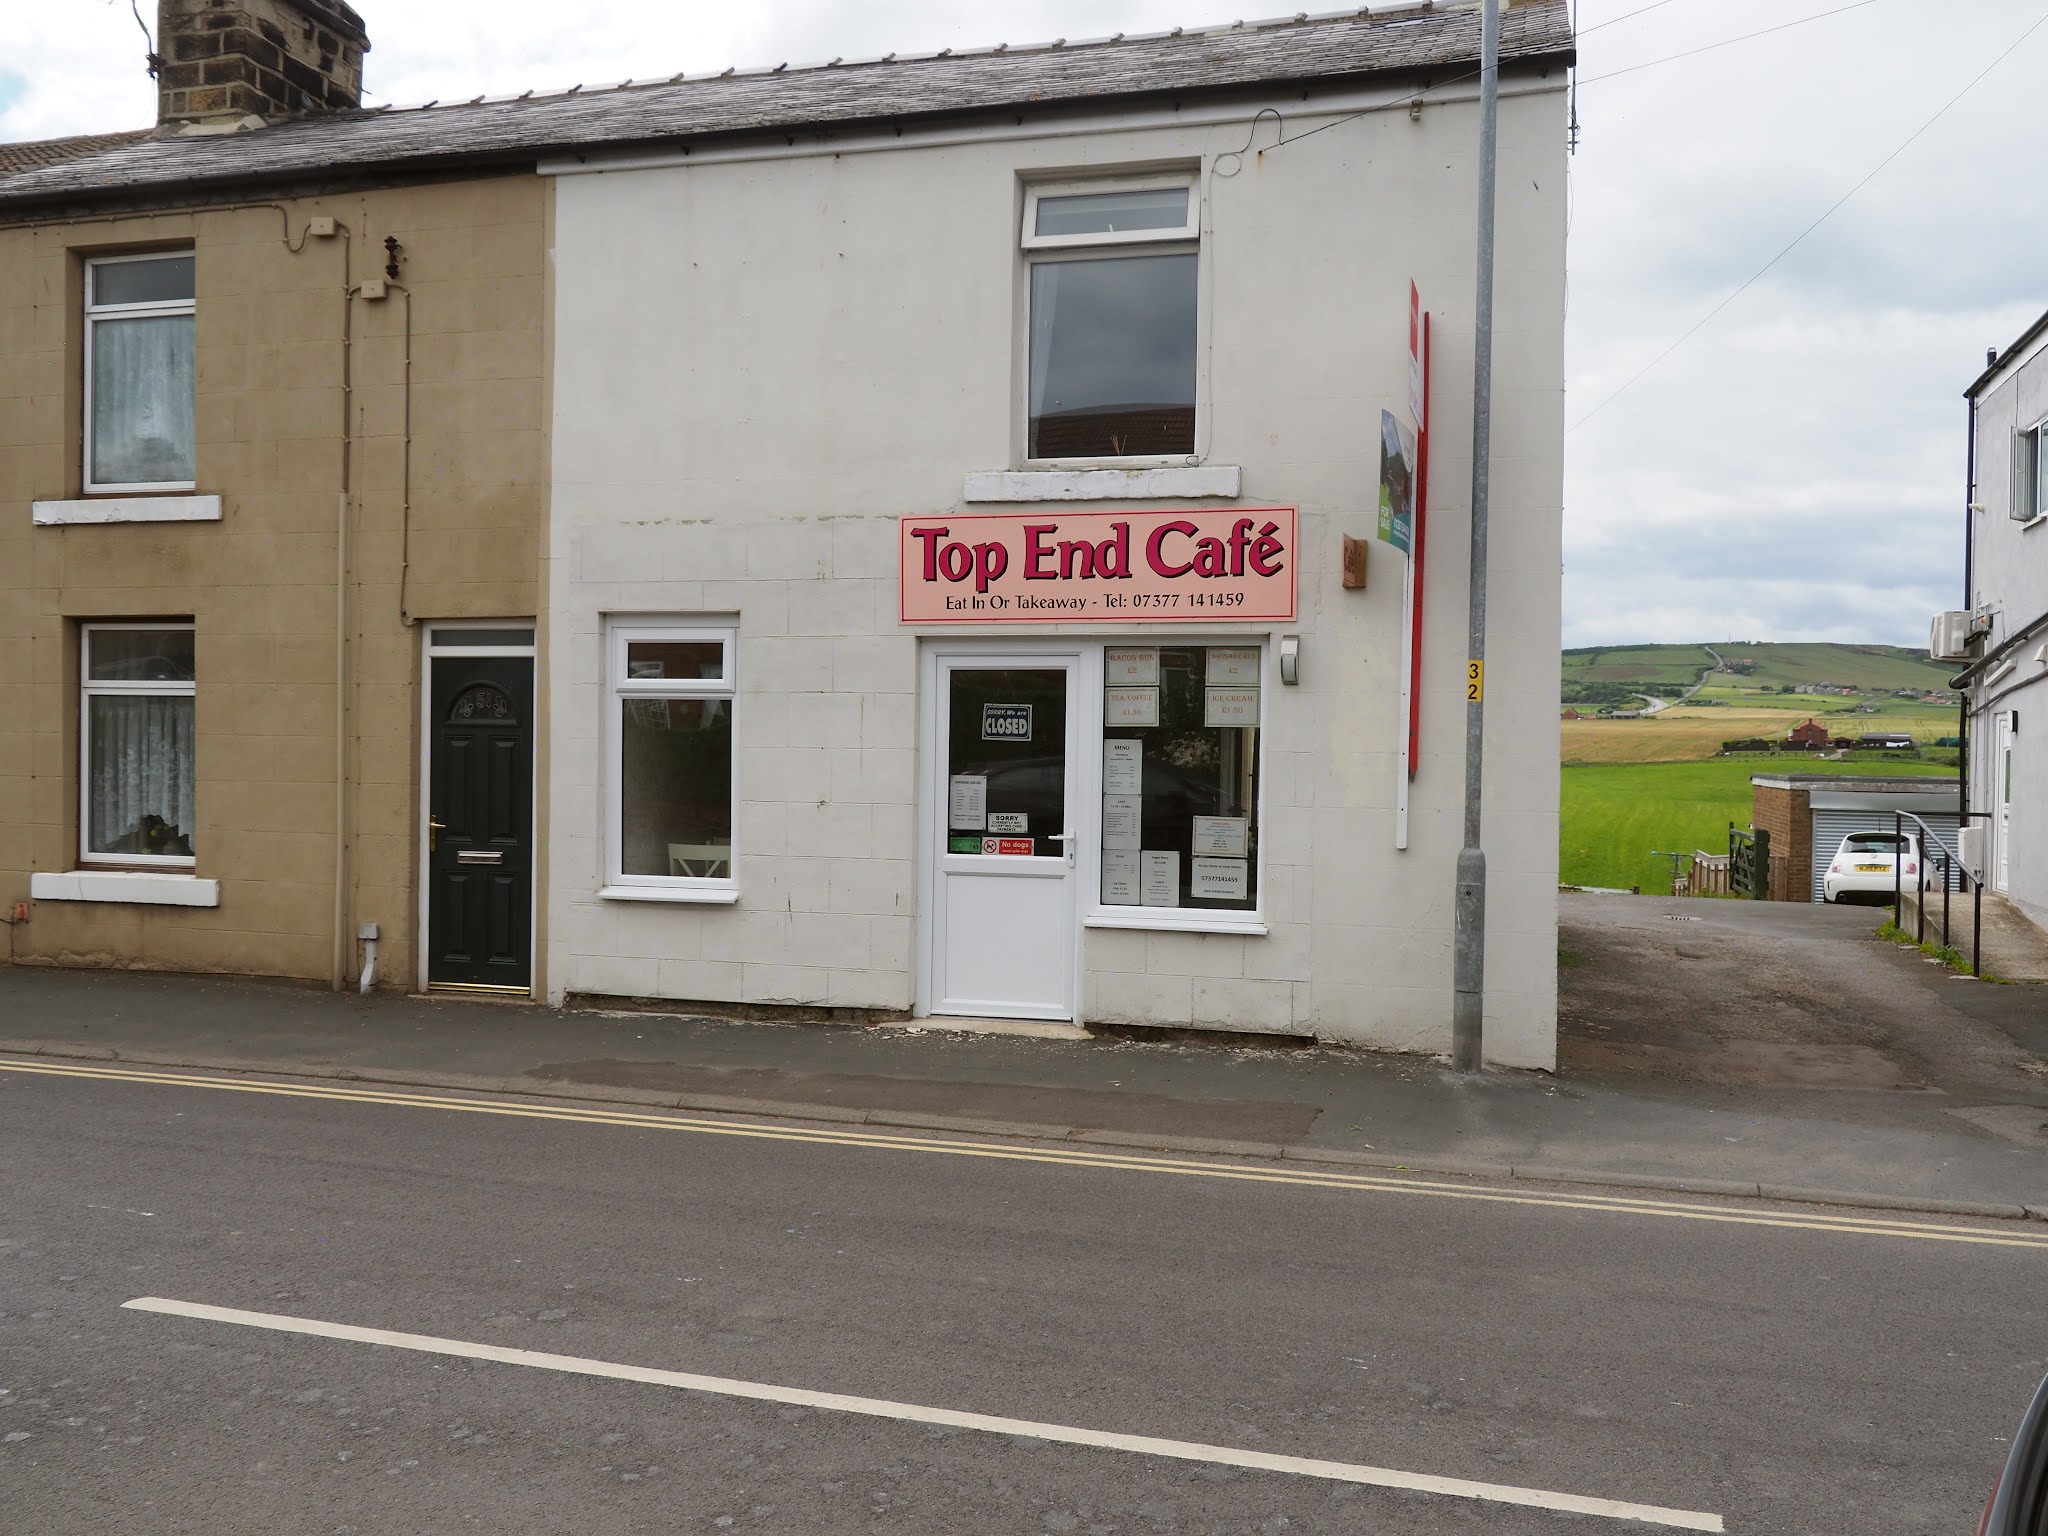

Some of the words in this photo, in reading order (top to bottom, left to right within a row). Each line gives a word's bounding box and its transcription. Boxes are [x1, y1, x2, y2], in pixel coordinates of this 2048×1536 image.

[910, 526, 1008, 594] Top
[1023, 521, 1132, 580] End
[1145, 518, 1284, 579] Café
[946, 595, 967, 611] Eat
[972, 595, 985, 610] In
[990, 595, 1010, 610] Or
[1015, 595, 1087, 612] Takeaway
[1104, 593, 1127, 608] Tel:
[1133, 594, 1180, 608] 07377
[1187, 592, 1245, 608] 141459
[1110, 653, 1137, 662] BACON
[1139, 653, 1154, 662] BUN
[1128, 666, 1137, 674] £2
[1469, 663, 1479, 680] 3
[1468, 684, 1478, 700] 2
[985, 717, 1028, 735] CLOSED
[1012, 841, 1029, 850] dogs
